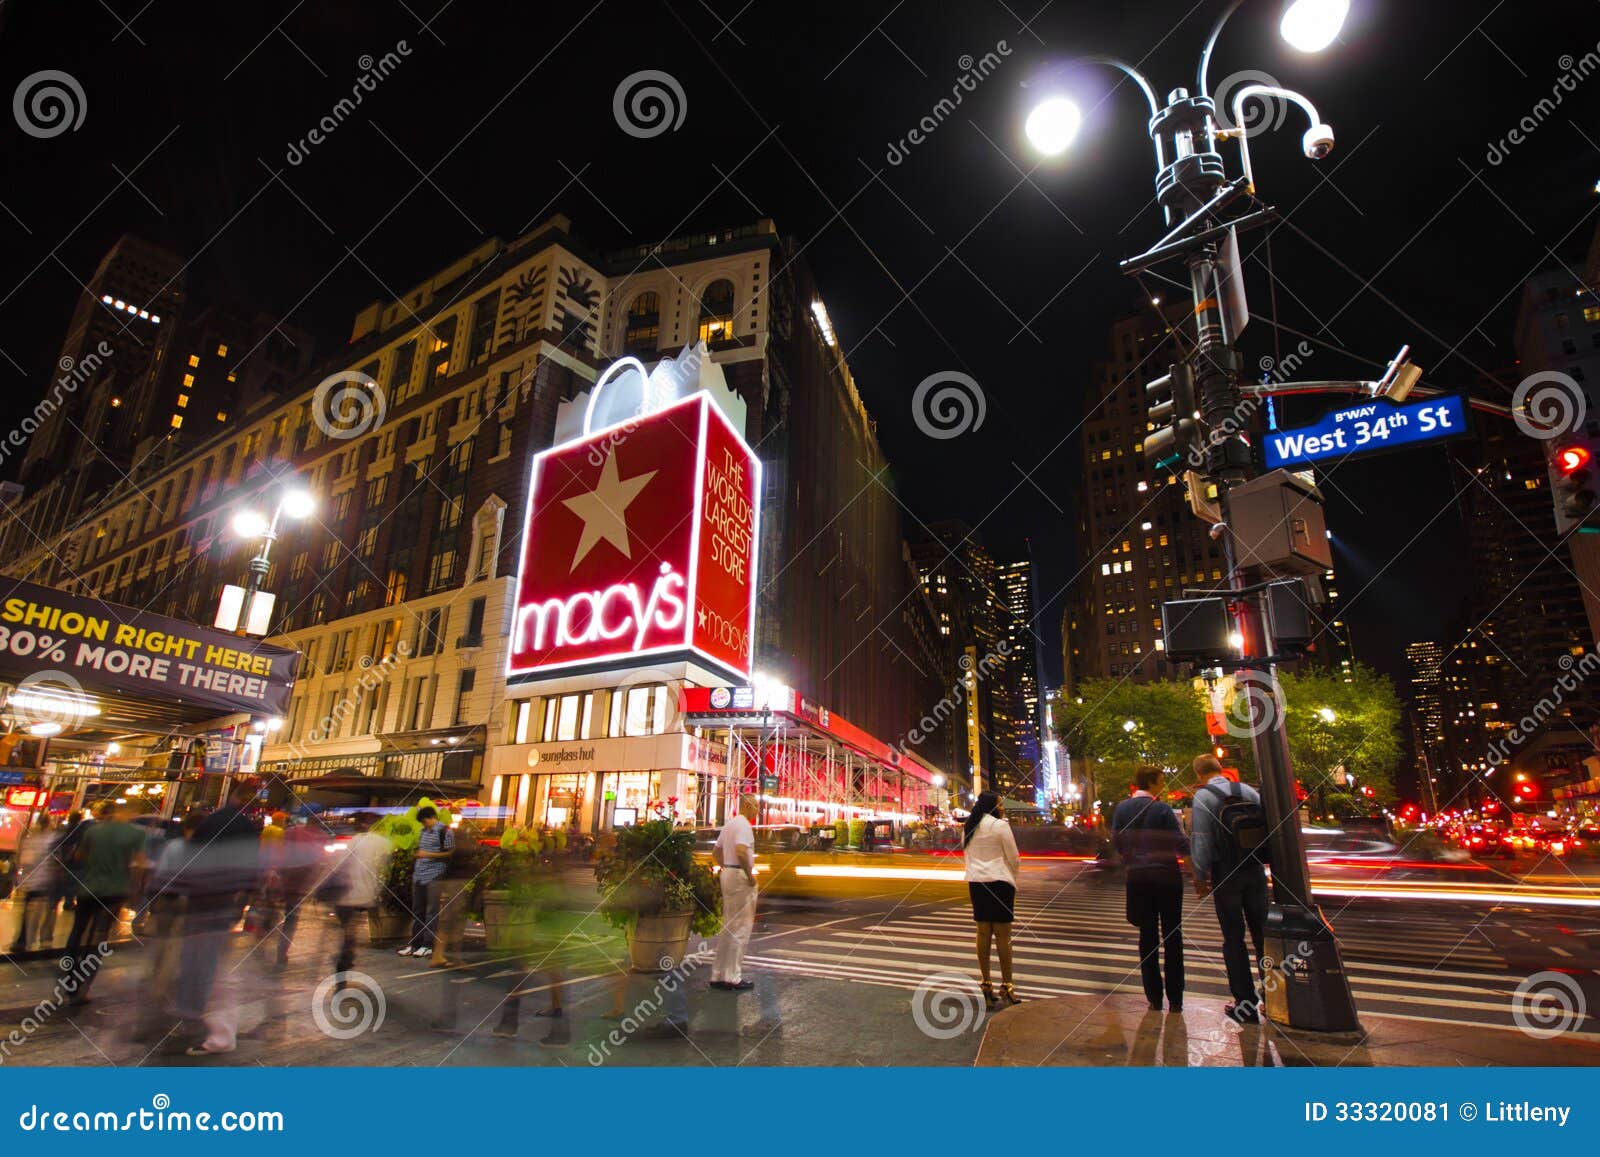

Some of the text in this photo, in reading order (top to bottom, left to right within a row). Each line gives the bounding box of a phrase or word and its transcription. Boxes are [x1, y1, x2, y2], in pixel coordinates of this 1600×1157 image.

[1274, 406, 1452, 459] West 34th St
[1335, 406, 1377, 422] B'WAY
[707, 460, 754, 532] WORLD'S
[724, 447, 744, 492] THE
[705, 492, 752, 559] LARGEST
[711, 533, 745, 585] STORE
[1, 598, 272, 676] SHION RIGHT HERE!
[75, 643, 171, 681] MORE
[178, 663, 268, 699] THERE!
[541, 747, 595, 765] sunglass hut
